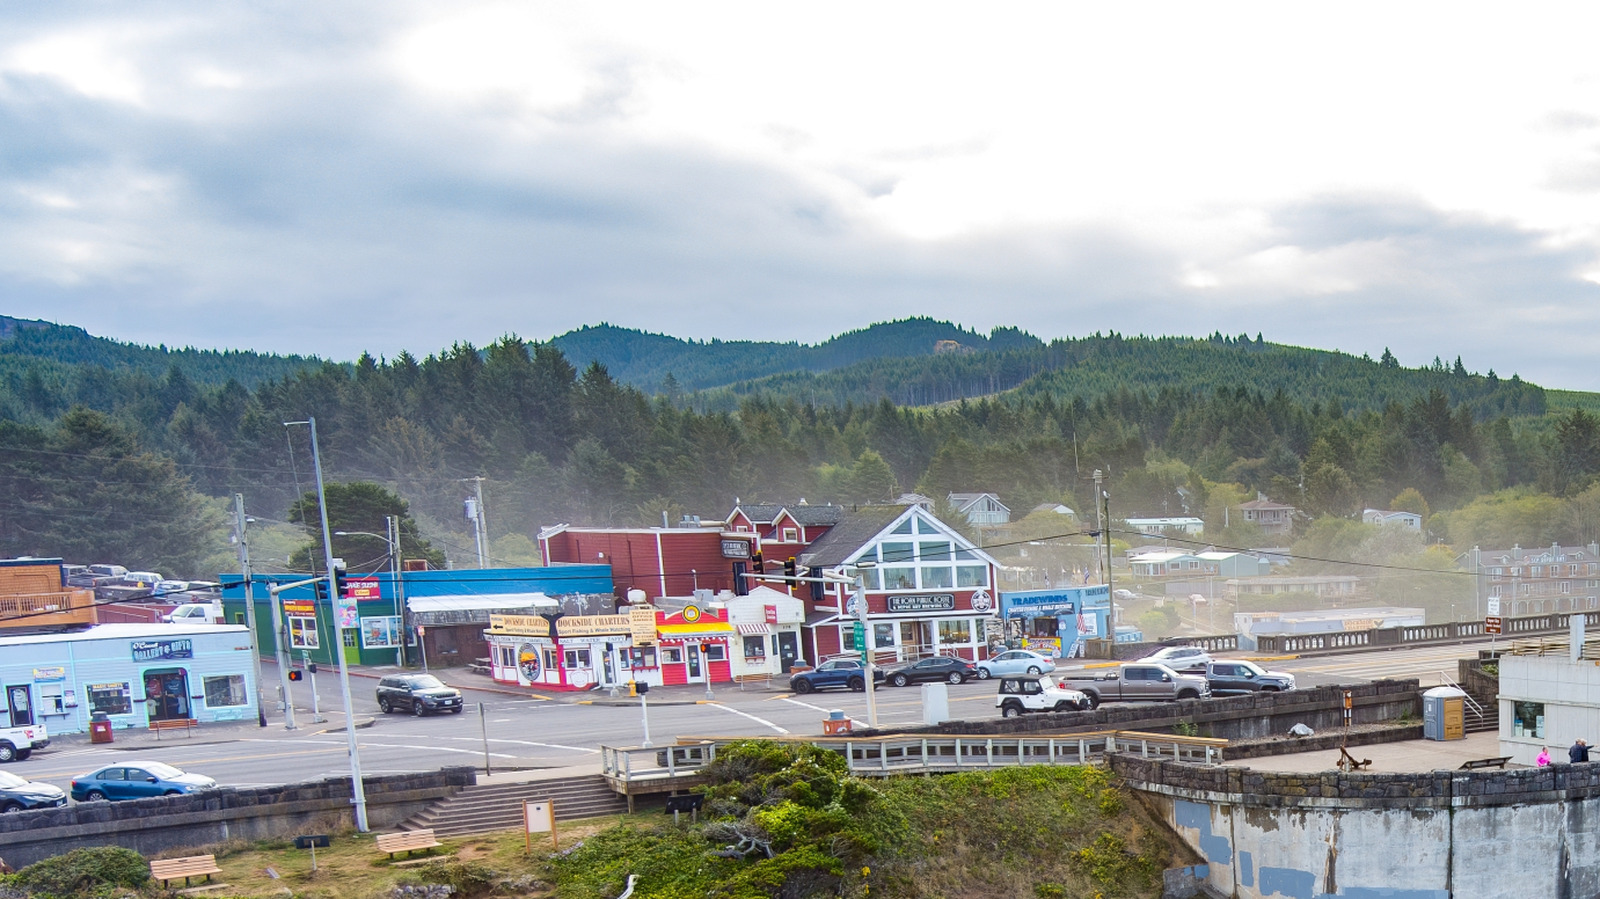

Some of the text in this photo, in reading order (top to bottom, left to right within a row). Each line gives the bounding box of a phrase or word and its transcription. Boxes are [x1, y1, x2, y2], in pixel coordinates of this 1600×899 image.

[1012, 595, 1068, 605] TRADEWINDS
[558, 616, 629, 627] DOCKSIDE CHARTERS
